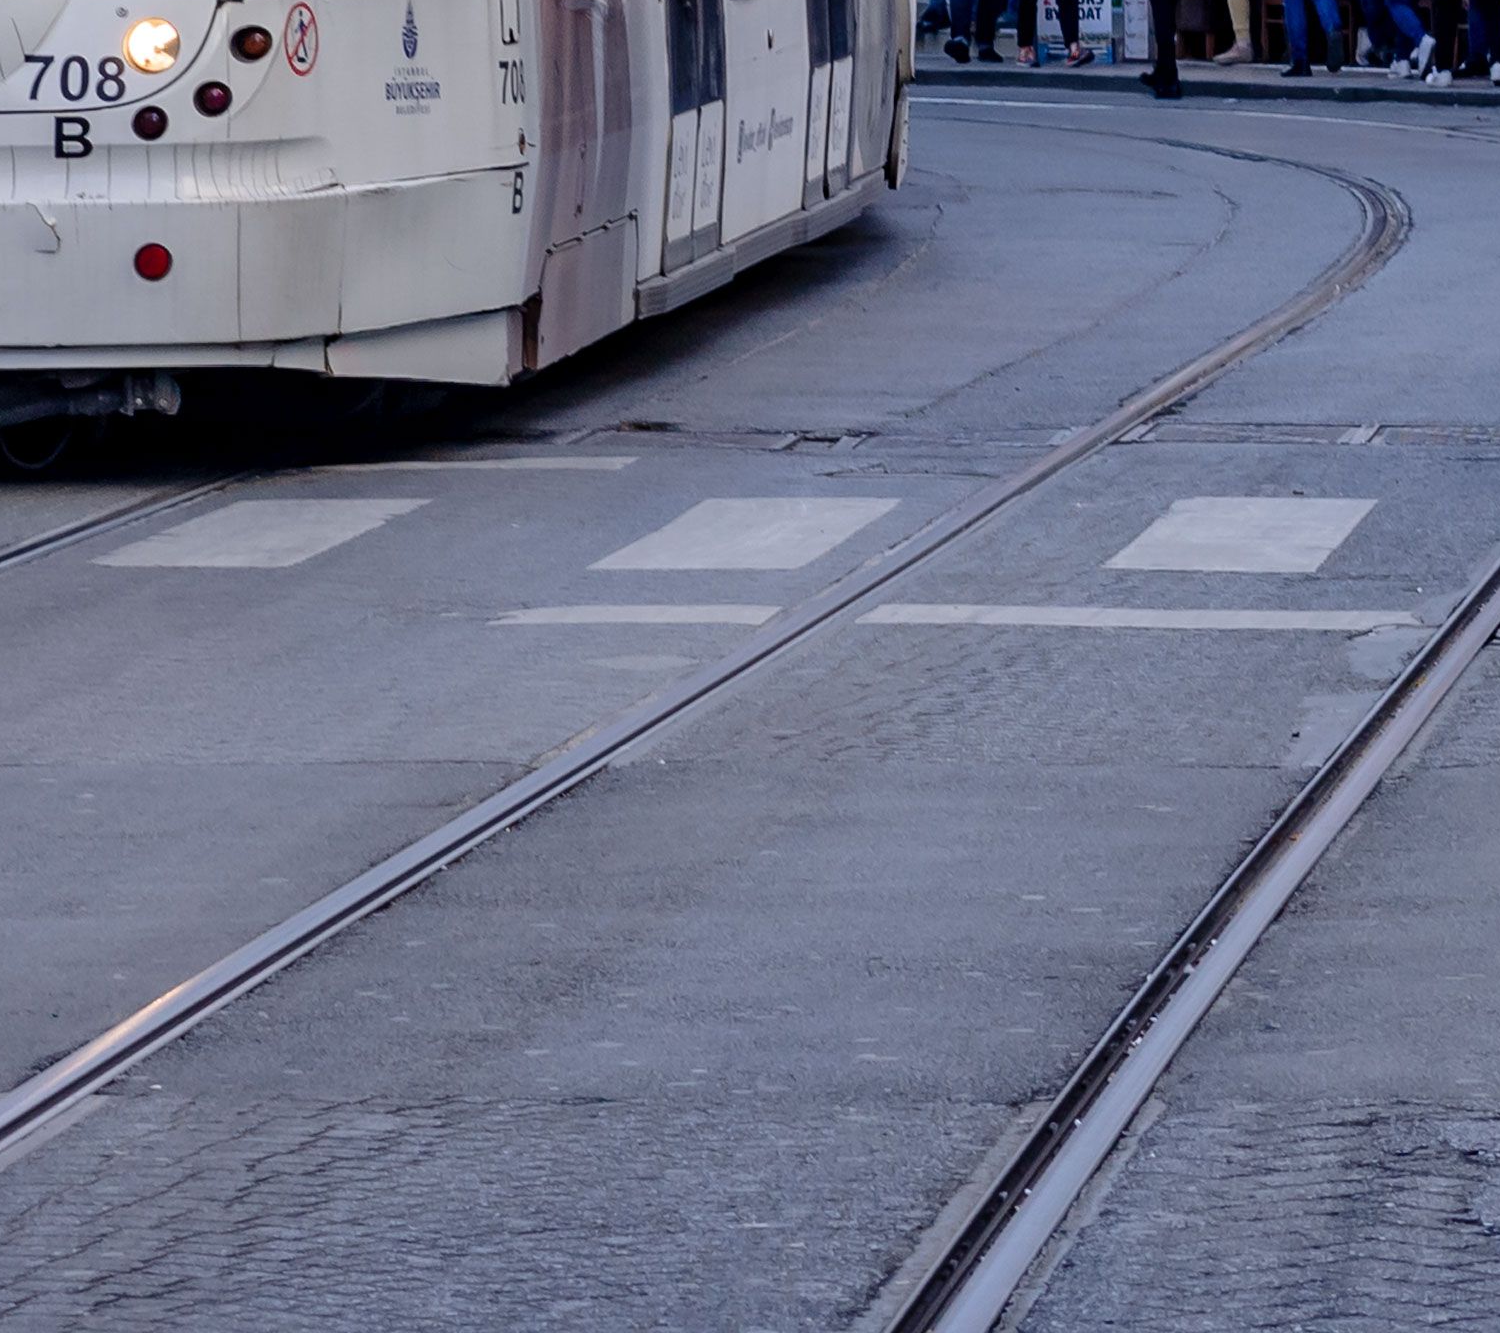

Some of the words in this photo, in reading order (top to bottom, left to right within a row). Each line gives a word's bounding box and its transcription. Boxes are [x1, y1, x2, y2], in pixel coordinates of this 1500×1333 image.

[24, 54, 127, 102] 708
[386, 79, 441, 102] BÜYÜKŞEHİR
[54, 116, 94, 159] B
[511, 171, 523, 214] B
